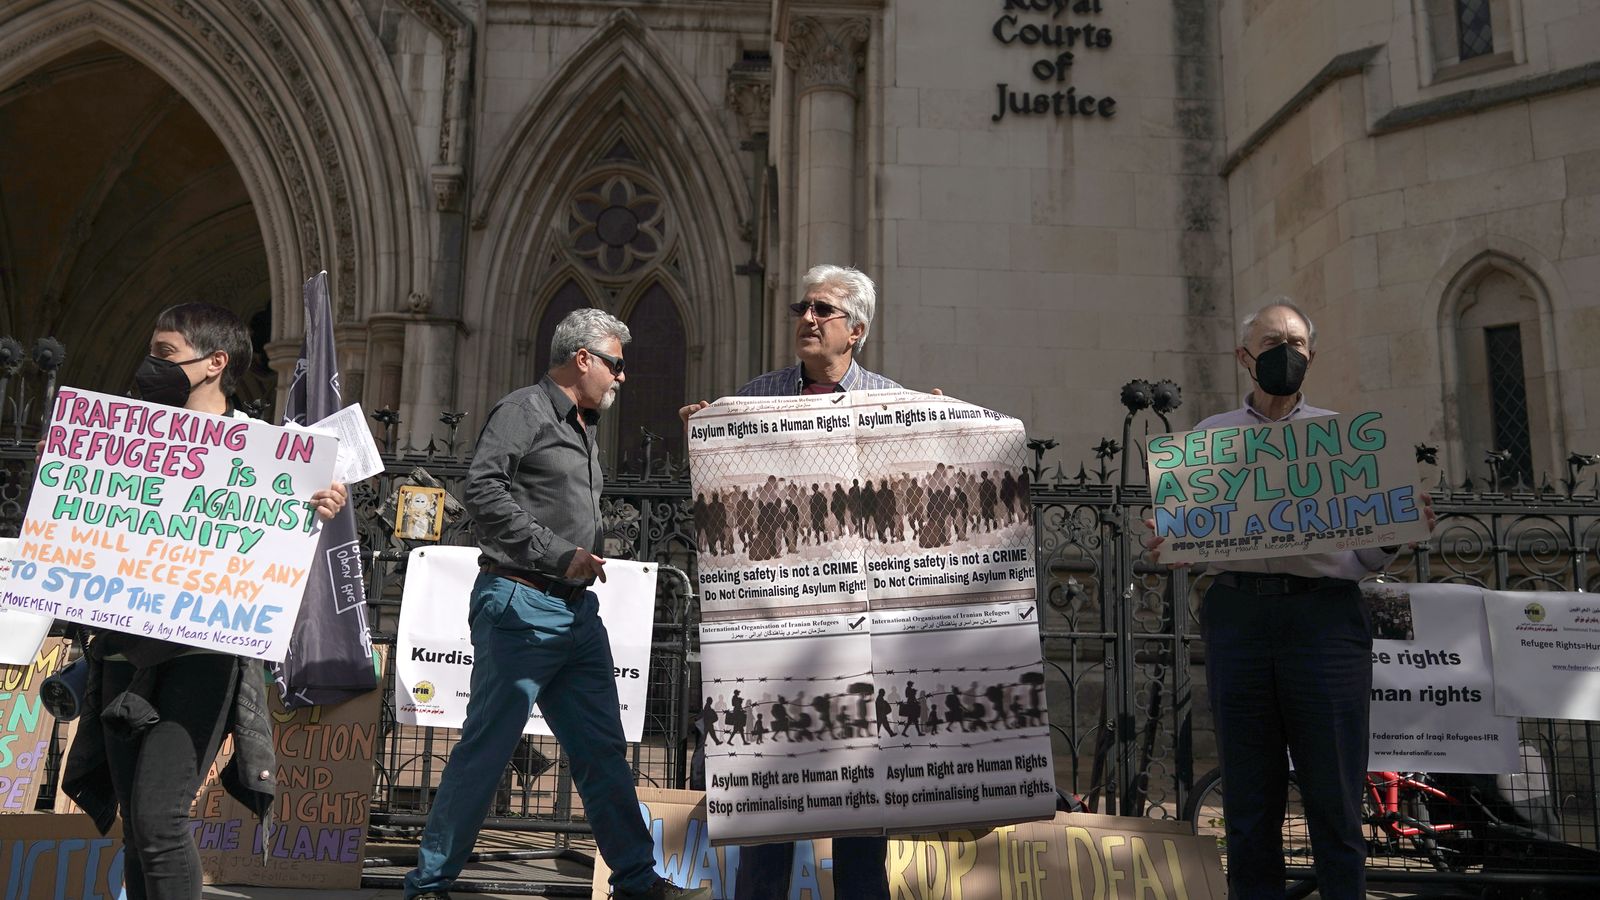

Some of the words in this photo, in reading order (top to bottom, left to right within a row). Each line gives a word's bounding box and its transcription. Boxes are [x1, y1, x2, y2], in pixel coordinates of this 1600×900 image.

[993, 15, 1112, 48] Courts
[1032, 51, 1074, 81] of
[992, 83, 1117, 122] Justice
[55, 390, 248, 451] TRAFFICKING
[275, 432, 314, 463] IN
[691, 424, 725, 442] Asylum
[728, 421, 758, 439] Rights
[760, 420, 769, 434] is
[771, 423, 778, 432] a
[781, 418, 814, 432] Human
[817, 415, 851, 432] Rights!
[858, 412, 893, 429] Asylum
[896, 409, 926, 427] Rights
[928, 408, 937, 421] is
[940, 410, 947, 420] a
[949, 408, 982, 420] Human
[1148, 411, 1386, 469] SEEKING
[47, 425, 208, 480] REFUGEES
[227, 457, 256, 488] is
[272, 473, 295, 496] a
[1155, 453, 1379, 504] ASYLUM
[39, 461, 165, 506] CRIME
[183, 485, 317, 533] AGAINST
[52, 494, 265, 554] HUMANITY
[1155, 502, 1238, 538] NOT
[1268, 485, 1420, 533] CRIME
[1172, 536, 1263, 551] MOVEMENT
[1271, 534, 1295, 544] FOR
[1305, 526, 1374, 541] JUSTICE
[25, 518, 58, 540] WE
[71, 526, 129, 552] WILL
[146, 539, 214, 566] FIGHT
[227, 556, 255, 576] BY
[262, 563, 305, 588] ANY
[868, 557, 911, 572] seeking
[914, 554, 946, 570] safety
[949, 553, 959, 566] is
[962, 552, 980, 565] not
[983, 553, 990, 563] a
[993, 549, 1027, 563] CRIME
[1215, 548, 1231, 557] Any
[21, 542, 97, 570] MEANS
[117, 558, 264, 602] NECESSARY
[700, 570, 741, 584] seeking
[743, 567, 776, 583] safety
[779, 566, 789, 579] is
[792, 566, 809, 578] not
[812, 567, 820, 576] a
[823, 561, 858, 575] CRIME
[874, 578, 886, 589] Do
[889, 576, 906, 588] Not
[908, 571, 970, 586] Criminalising
[972, 569, 1007, 584] Asylum
[1009, 566, 1035, 582] Right!
[11, 560, 37, 580] TO
[41, 566, 125, 604] STOP
[127, 587, 166, 615] THE
[170, 591, 283, 634] PLANE
[705, 590, 717, 601] Do
[719, 588, 736, 600] Not
[738, 584, 800, 599] Criminalising
[802, 582, 836, 597] Asylum
[839, 579, 867, 595] Right!
[2, 592, 61, 615] MOVEMENT
[66, 606, 84, 619] FOR
[91, 610, 134, 628] JUSTICE
[143, 621, 155, 635] By
[157, 622, 173, 640] Any
[176, 625, 208, 640] Means
[212, 631, 273, 655] Necessary
[702, 625, 741, 633] International
[812, 619, 840, 627] Refugees
[871, 616, 911, 625] International
[912, 614, 952, 623] Organisation
[984, 610, 1010, 618] Refugees
[411, 647, 474, 665] Kurdis
[1520, 639, 1554, 649] Refugee
[1397, 650, 1461, 669] rights
[412, 687, 430, 695] IFIR
[1420, 685, 1482, 706] rights
[1372, 732, 1414, 740] Federation
[1416, 732, 1425, 741] of
[1426, 733, 1445, 742] Iraqi
[16, 741, 48, 772] of
[886, 764, 924, 782] Asylum
[927, 761, 955, 779] Right
[957, 762, 974, 775] are
[976, 758, 1013, 773] Human
[1015, 753, 1048, 772] Rights
[275, 765, 333, 790] AND
[711, 773, 749, 791] Asylum
[752, 771, 779, 789] Right
[782, 772, 799, 784] are
[802, 768, 839, 783] Human
[841, 765, 875, 783] Rights
[709, 800, 733, 816] Stop
[736, 796, 805, 812] criminalising
[807, 794, 843, 809] human
[845, 791, 880, 808] rights.
[884, 791, 909, 807] Stop
[912, 786, 979, 801] criminalising
[981, 783, 1017, 798] human
[1020, 780, 1053, 797] rights.
[252, 791, 369, 826] IGHTS
[251, 823, 363, 863] PLANE
[993, 825, 1048, 900] THE
